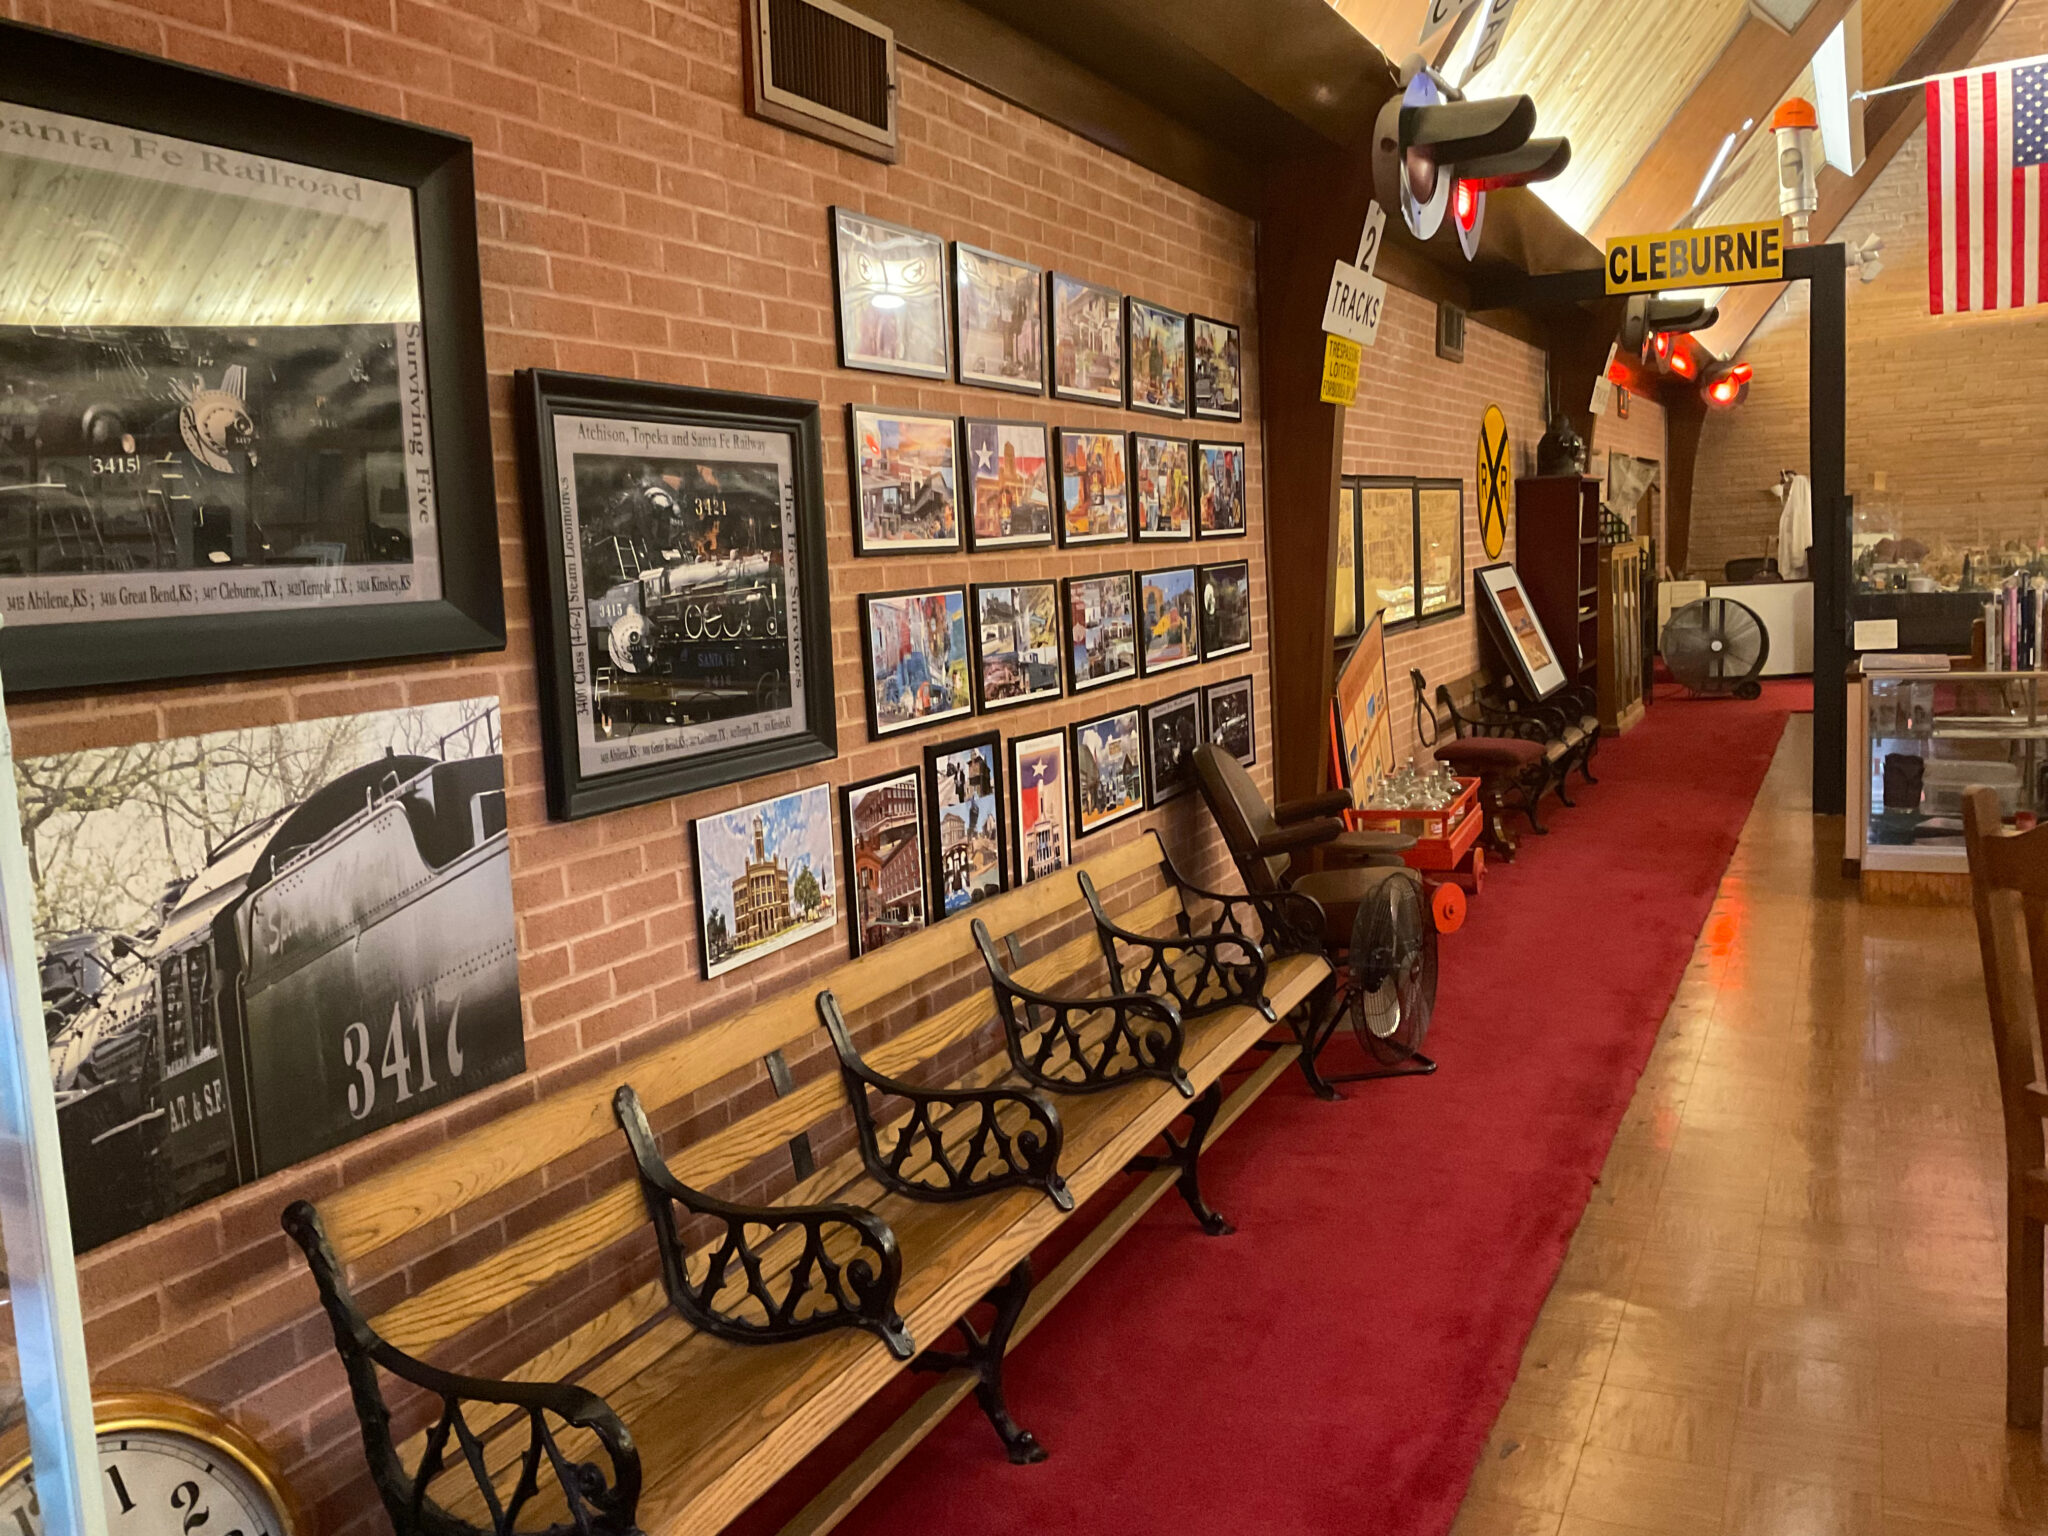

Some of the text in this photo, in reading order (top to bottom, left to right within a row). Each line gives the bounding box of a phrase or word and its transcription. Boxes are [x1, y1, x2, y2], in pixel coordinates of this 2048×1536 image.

[0, 115, 363, 202] anta Fe Railroad
[1359, 225, 1377, 272] 2
[1608, 228, 1780, 285] CLEBURNE
[1332, 280, 1380, 329] TRACKS
[405, 324, 432, 524] Surviving Five
[578, 422, 767, 456] Atchison, Topeka and Santa Fe Railway
[92, 457, 138, 474] 3415
[560, 477, 576, 559] Locomotives
[119, 586, 148, 605] Great
[569, 562, 580, 603] Steam
[784, 478, 803, 689] The Five Survivors
[574, 651, 585, 686] Class
[342, 991, 464, 1121] 3417
[104, 1464, 137, 1515] 1
[170, 1480, 209, 1536] 2
